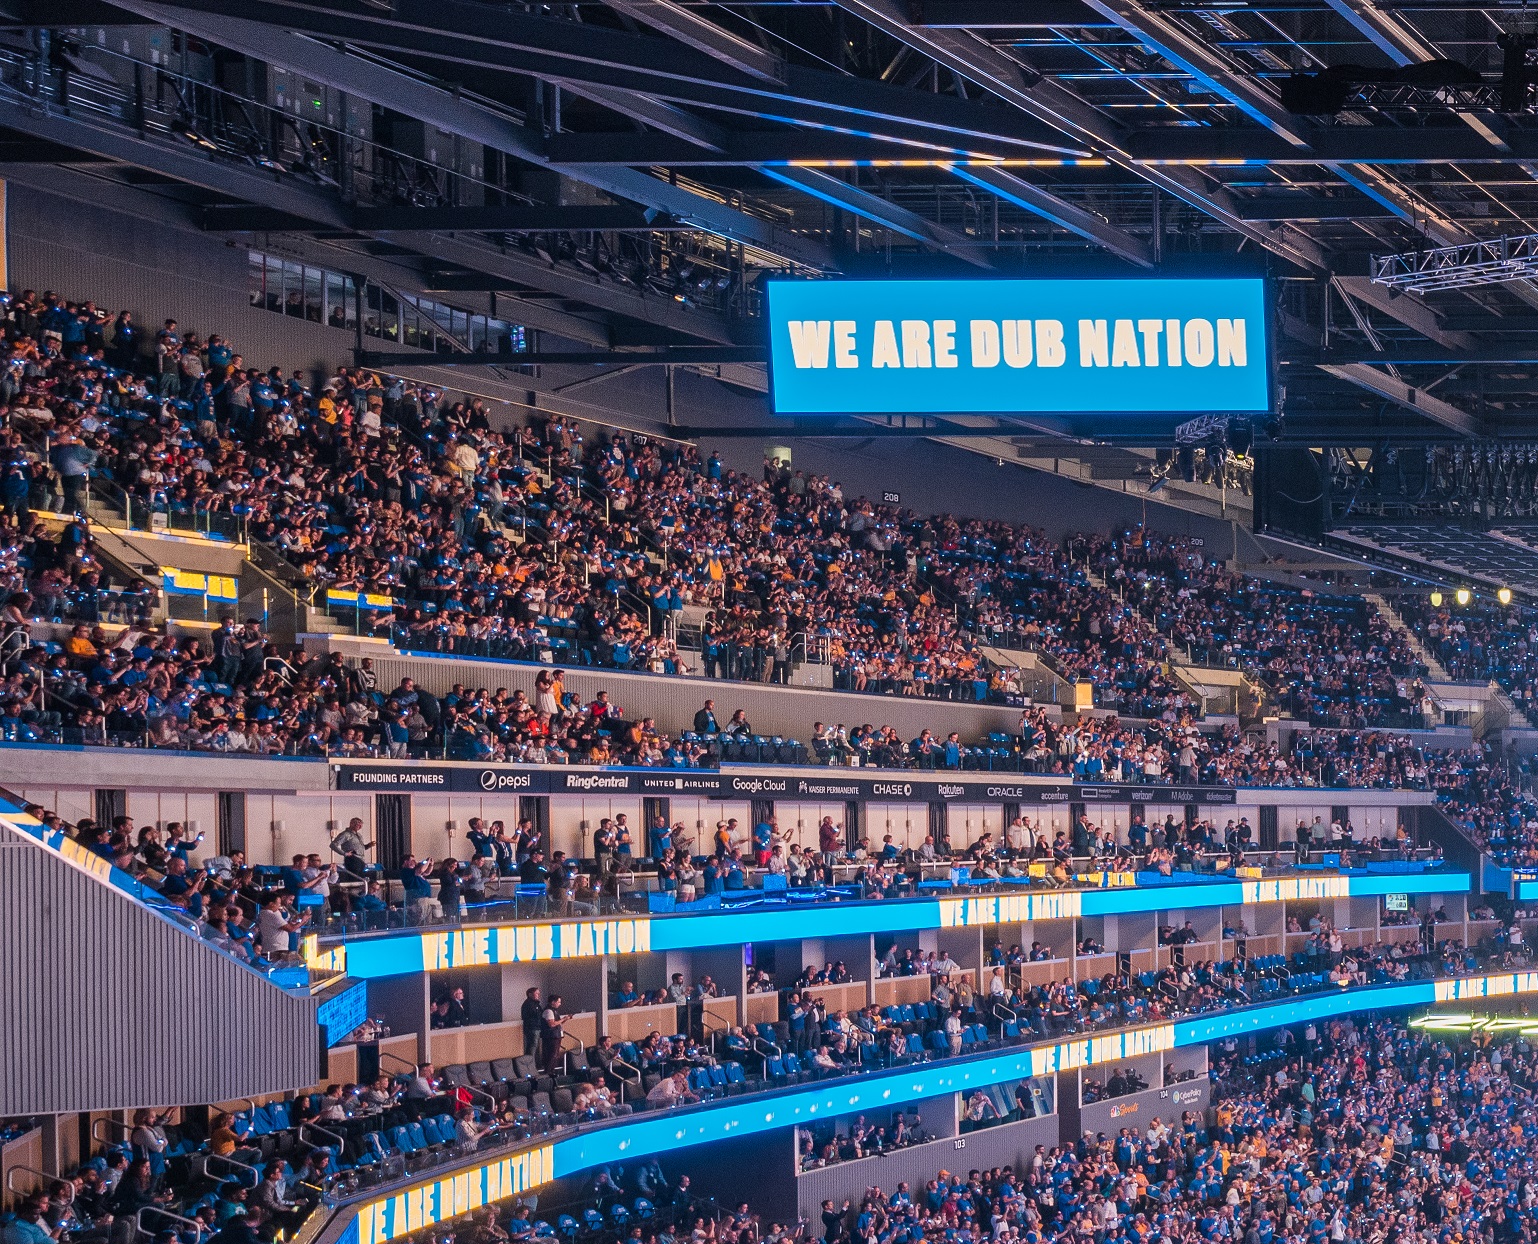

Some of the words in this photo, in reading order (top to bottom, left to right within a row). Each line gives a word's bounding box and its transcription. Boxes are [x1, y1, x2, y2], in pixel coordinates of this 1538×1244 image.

[788, 320, 859, 369] WE
[872, 320, 958, 369] ARE
[970, 319, 1066, 369] DUB
[1078, 318, 1247, 367] NATION
[634, 434, 648, 445] 207
[884, 492, 899, 503] 208
[354, 773, 397, 784] FOUNDING
[400, 774, 444, 785] PARTNERS
[499, 775, 530, 789] pepsi
[567, 774, 629, 789] RingCentral
[645, 779, 674, 787] UNITED
[684, 780, 720, 788] AIRLINES
[733, 778, 763, 793] Google
[764, 779, 786, 791] Cloud
[809, 785, 826, 794] KAISER
[827, 786, 859, 795] PERMANENTE
[873, 784, 903, 795] CHASE
[938, 784, 964, 795] Rakuten
[987, 787, 1022, 797] ORACLE
[1041, 791, 1069, 800] accenture
[422, 931, 449, 972] WE
[452, 928, 490, 968] ARE
[497, 924, 553, 964] DUB
[560, 919, 651, 959] NATION
[1160, 1089, 1169, 1100] 104
[954, 1139, 966, 1150] 103
[393, 1184, 435, 1239] ARE
[487, 1144, 554, 1204] NATION
